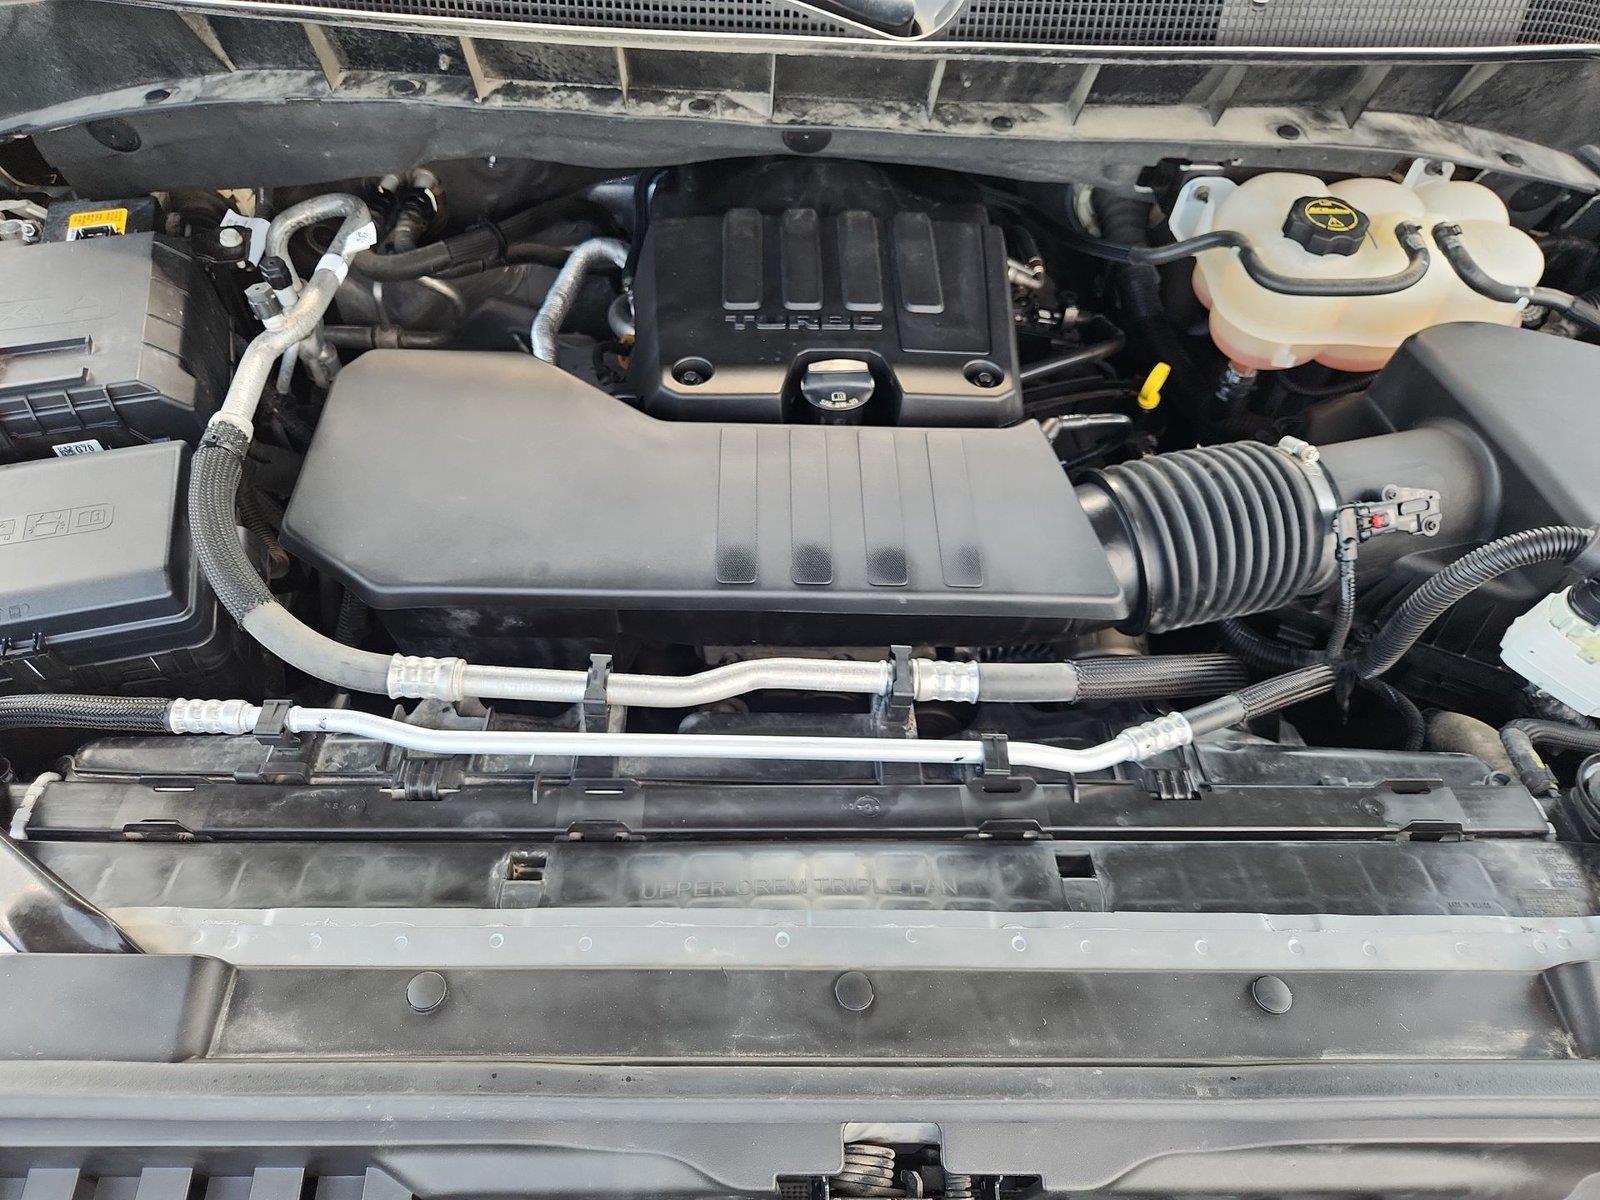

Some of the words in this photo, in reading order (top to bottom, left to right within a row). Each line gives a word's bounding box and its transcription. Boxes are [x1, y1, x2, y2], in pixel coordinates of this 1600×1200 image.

[725, 315, 882, 330] TURBO
[641, 880, 726, 898] UPPER
[814, 878, 899, 895] TRIPLE
[911, 879, 959, 895] FAN
